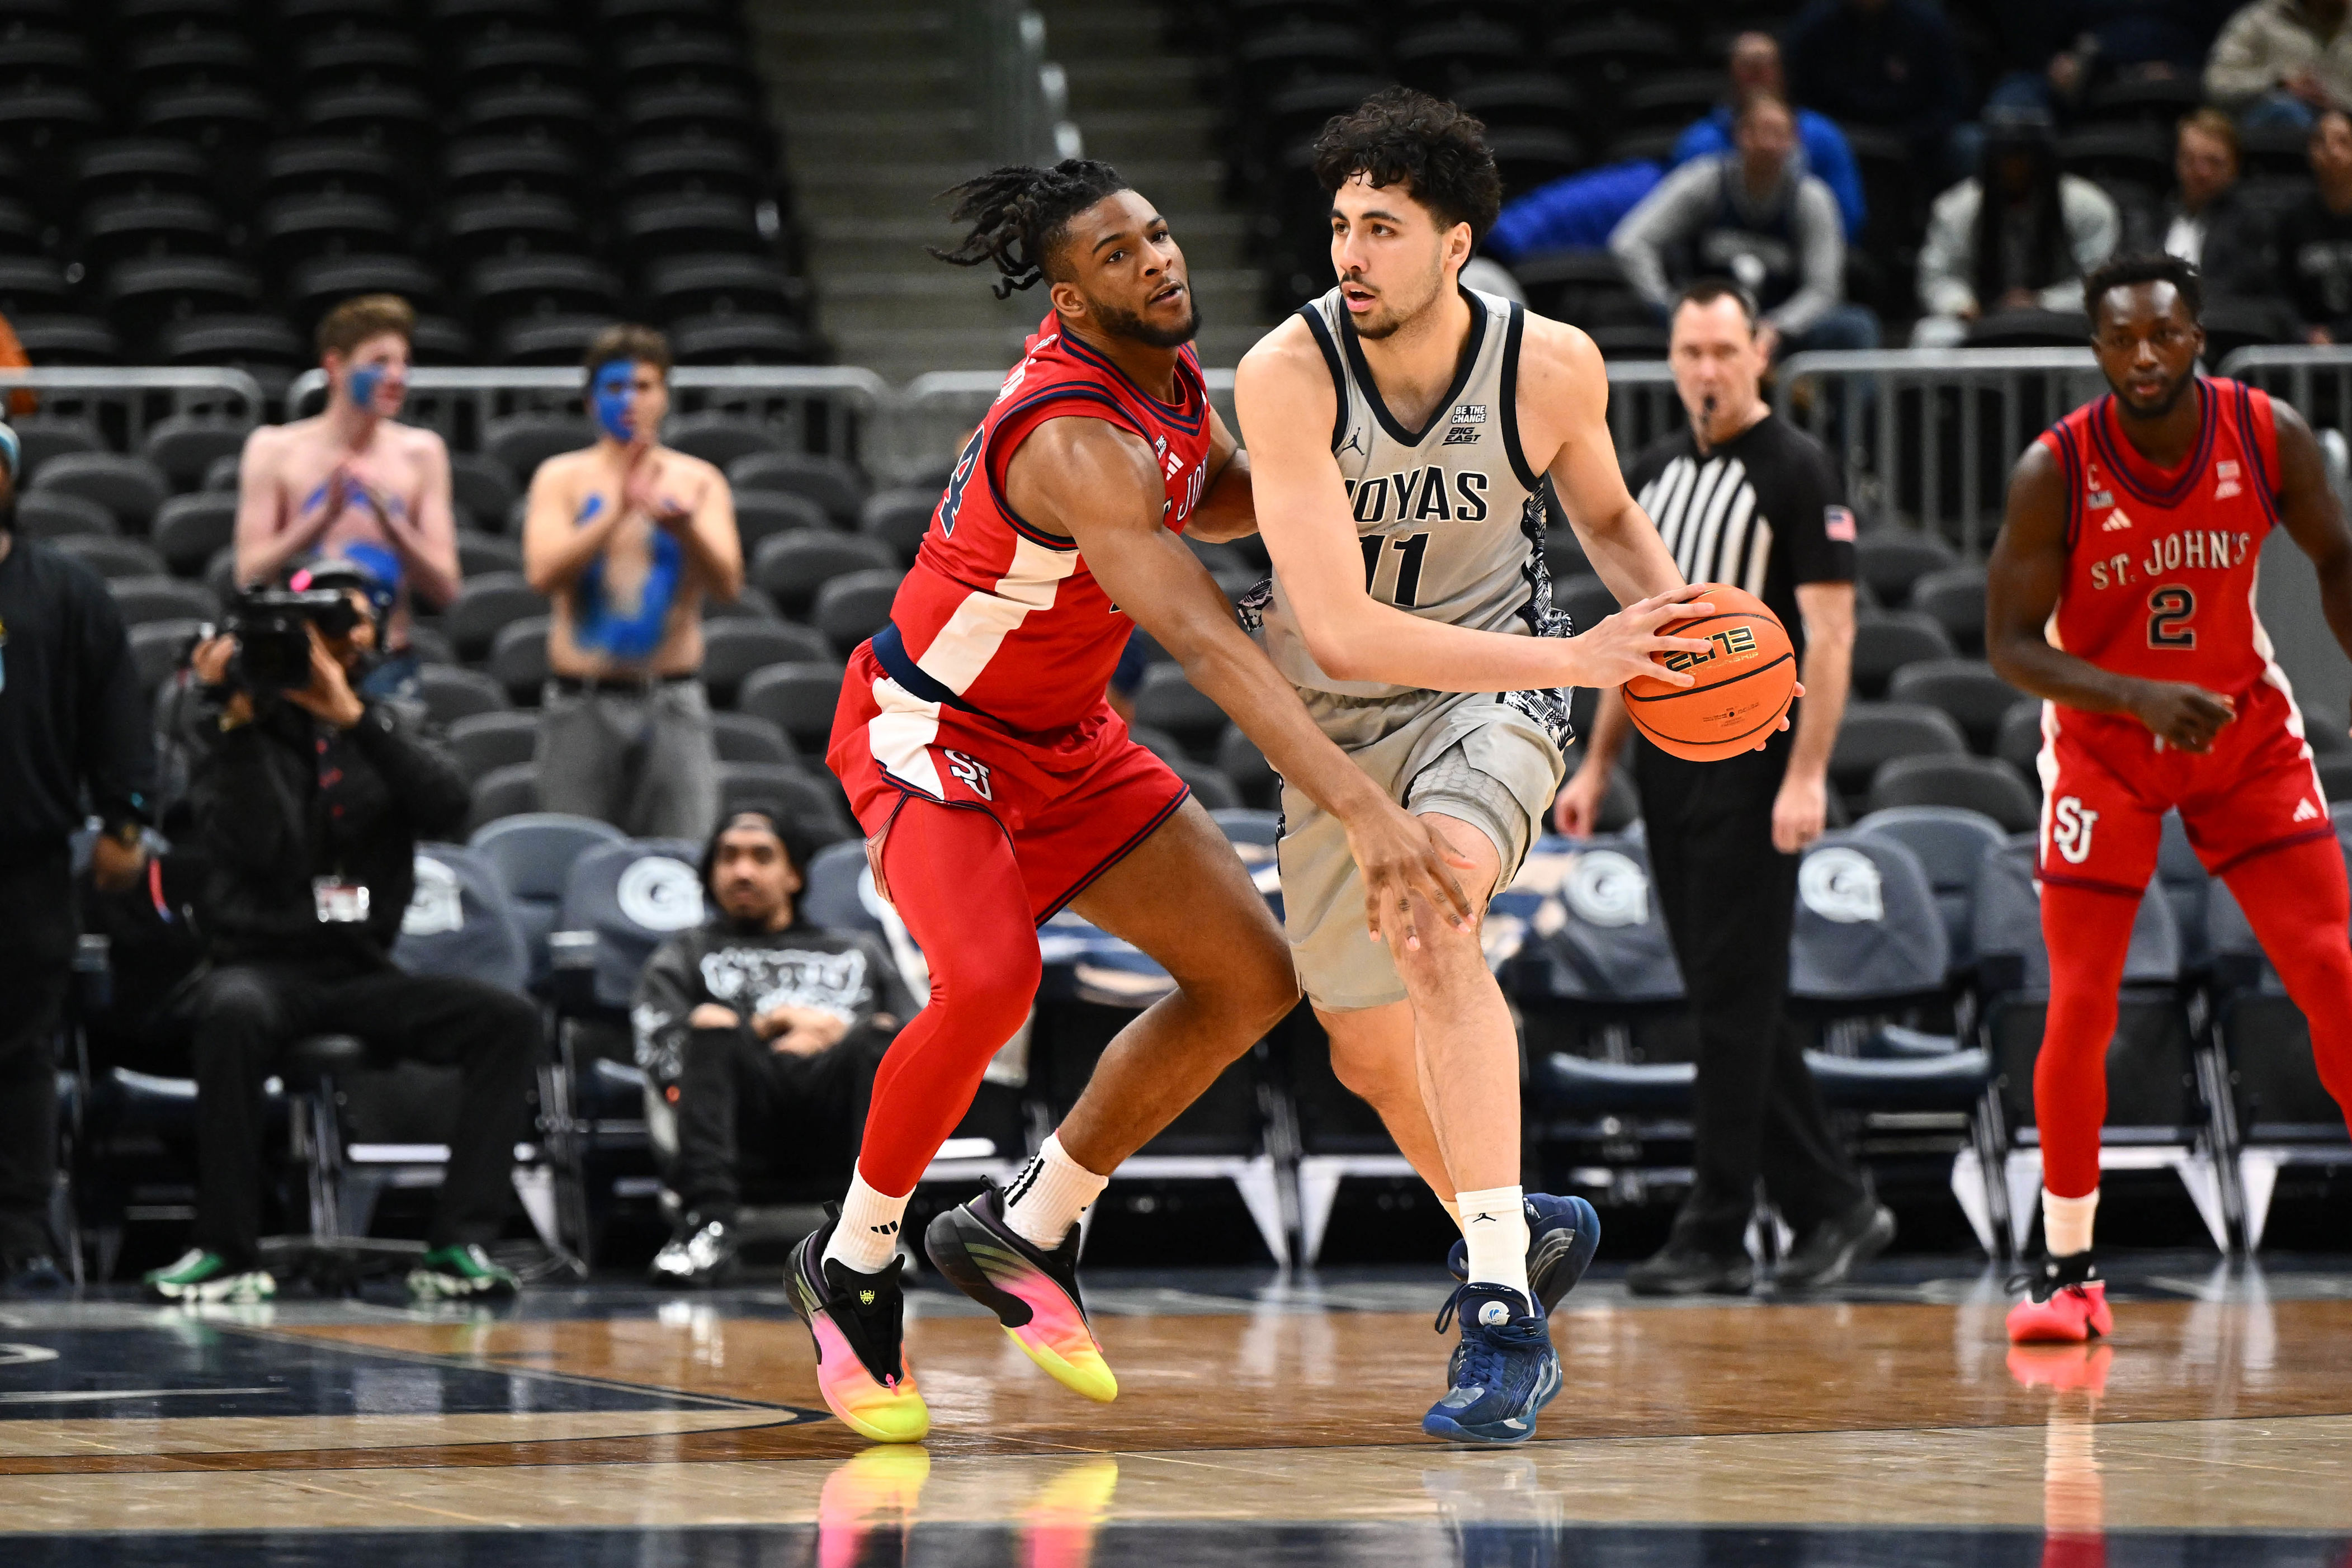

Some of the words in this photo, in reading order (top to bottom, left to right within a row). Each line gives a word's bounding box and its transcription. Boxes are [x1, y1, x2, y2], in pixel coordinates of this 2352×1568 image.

[1452, 414, 1486, 423] CHANGE
[1455, 406, 1467, 414] BE
[1469, 405, 1486, 414] THE
[1358, 531, 1432, 608] 11
[2091, 552, 2136, 590] ST.
[2143, 530, 2250, 576] JOHN'S
[2147, 584, 2196, 650] 2
